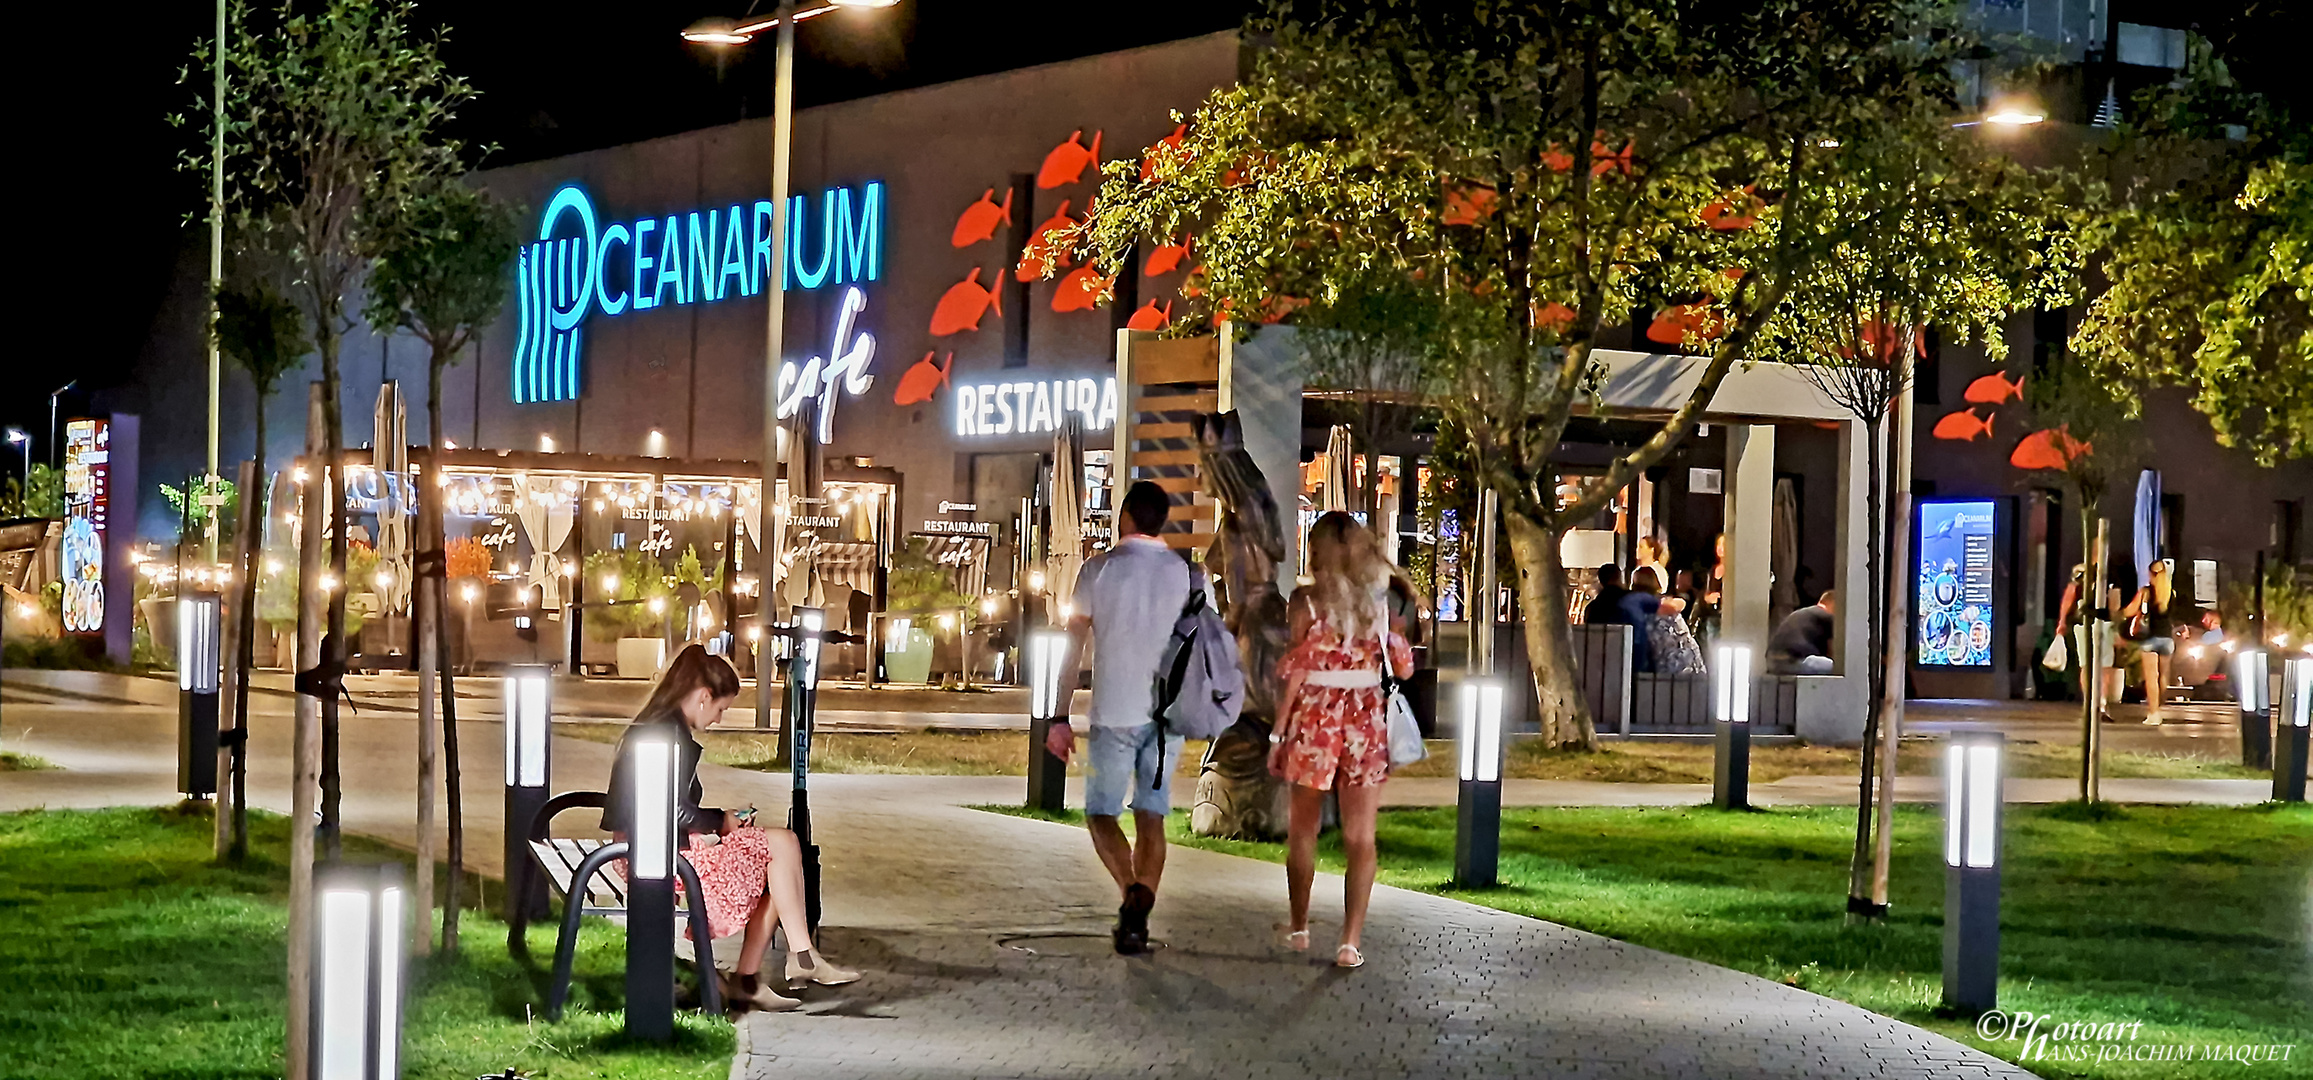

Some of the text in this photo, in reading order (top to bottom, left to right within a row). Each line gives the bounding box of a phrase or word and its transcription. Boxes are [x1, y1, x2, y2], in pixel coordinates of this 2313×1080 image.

[541, 182, 880, 330] OCEANARIUM
[957, 377, 1118, 436] RESTAURA
[786, 516, 840, 528] STAURANT
[924, 521, 989, 533] RESTAURANT
[481, 523, 516, 552] cafe
[639, 529, 673, 557] cafe
[939, 541, 972, 568] cafe
[797, 733, 806, 784] TIER
